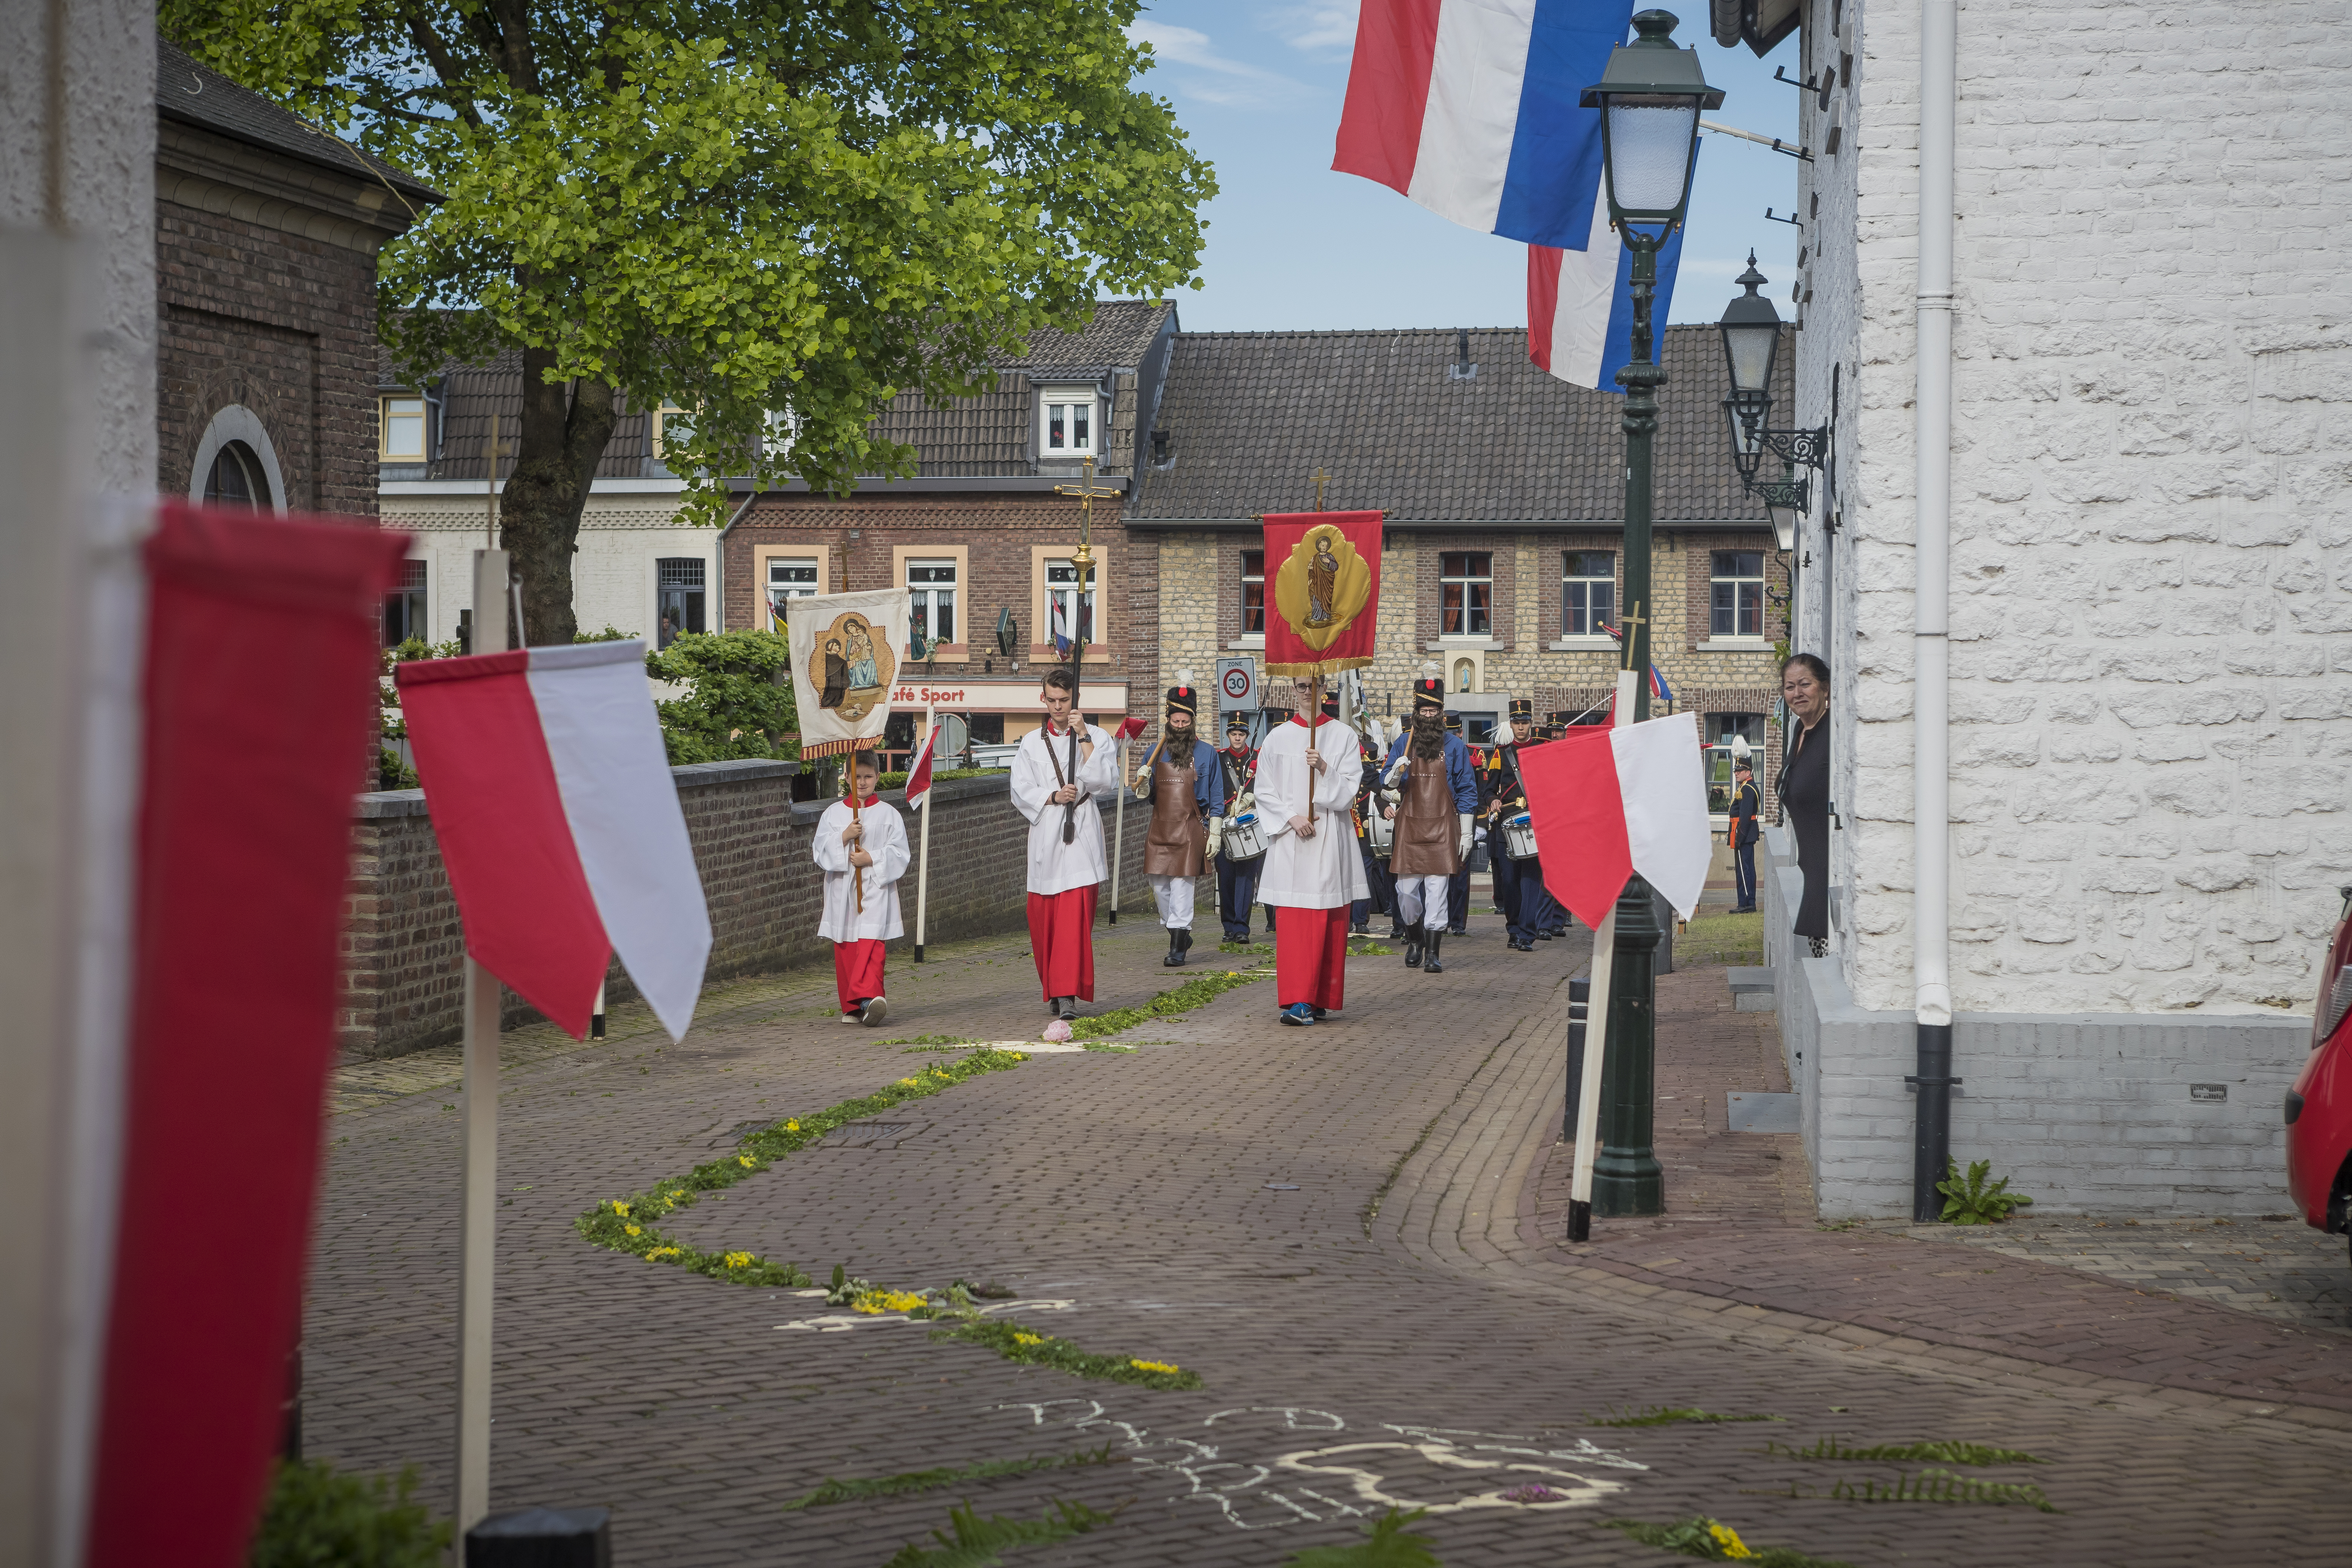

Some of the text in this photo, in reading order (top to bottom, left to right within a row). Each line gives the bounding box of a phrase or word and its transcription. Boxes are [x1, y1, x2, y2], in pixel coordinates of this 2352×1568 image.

[1228, 678, 1245, 689] 30
[892, 687, 965, 705] afé Sport
